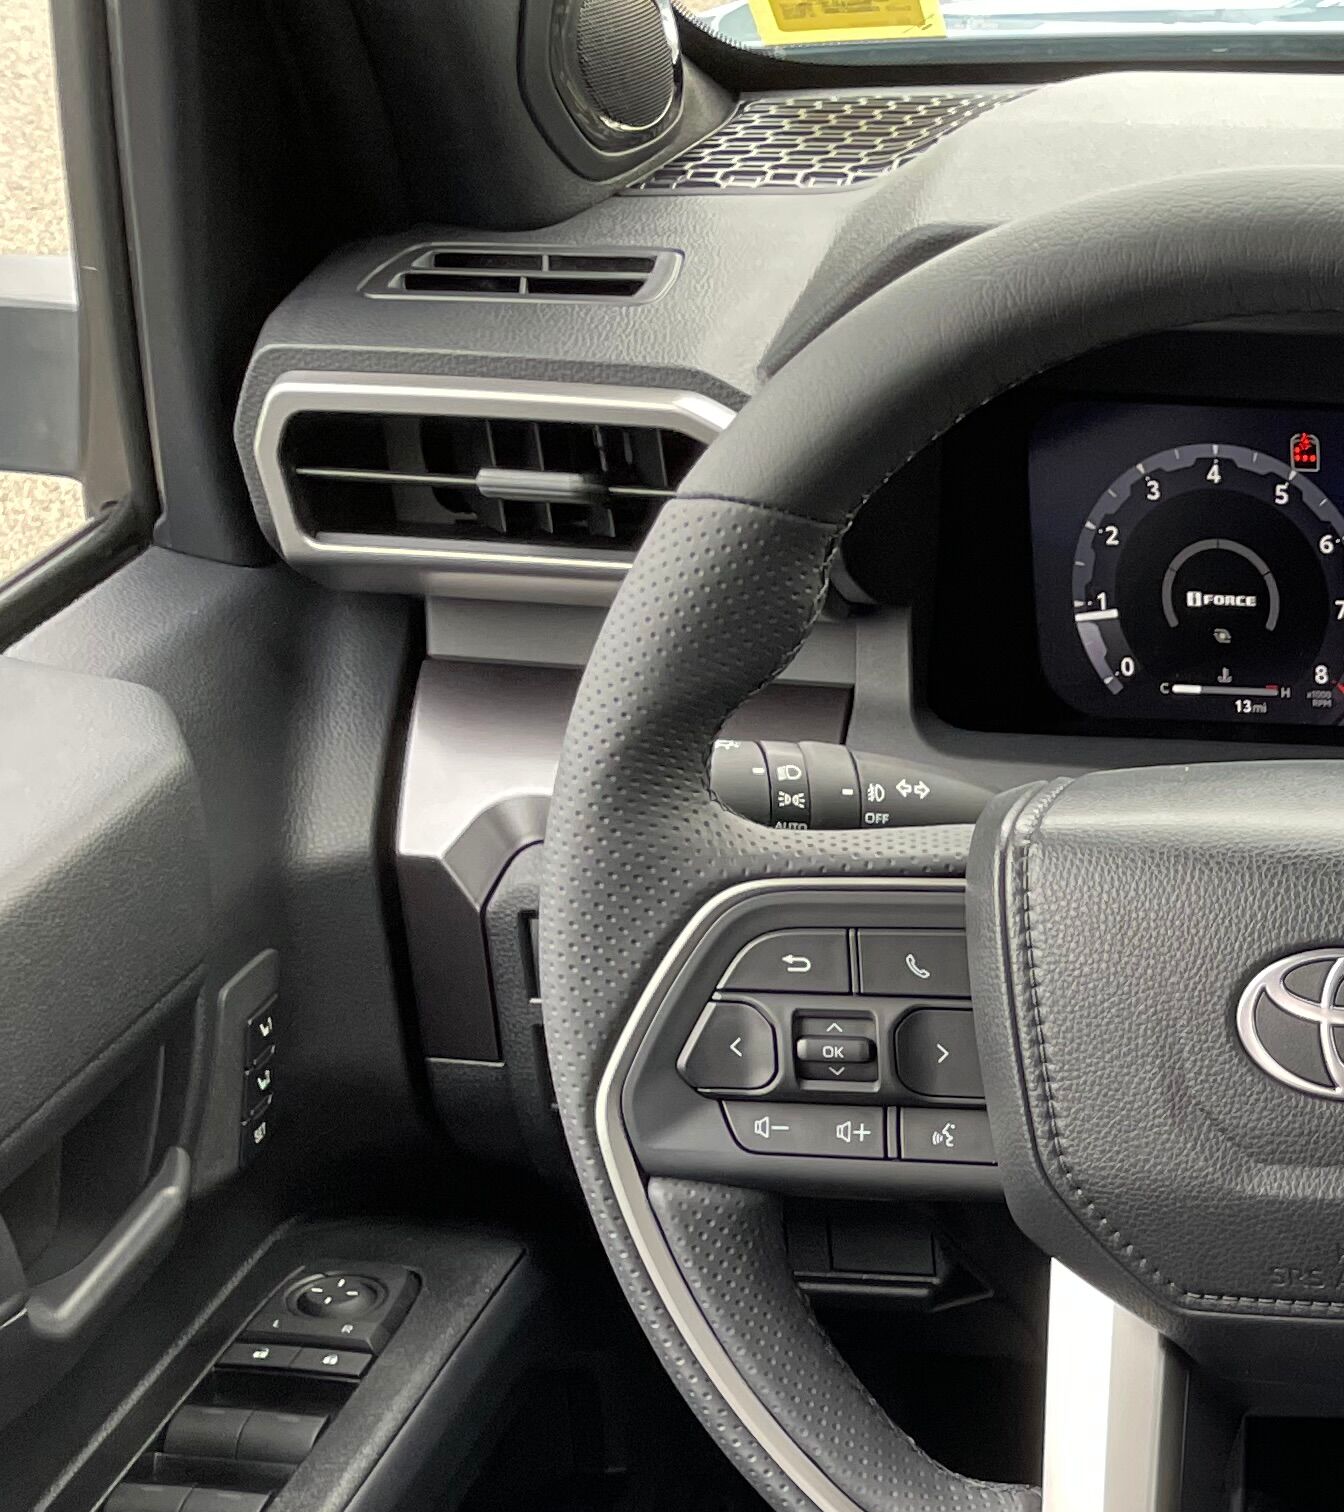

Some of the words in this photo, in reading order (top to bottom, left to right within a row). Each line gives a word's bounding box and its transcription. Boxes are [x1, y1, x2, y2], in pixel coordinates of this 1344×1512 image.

[1207, 463, 1221, 484] 4
[1147, 480, 1161, 500] 3
[1274, 485, 1288, 504] 5
[1105, 525, 1119, 545] 2
[1319, 535, 1333, 554] 6
[1097, 593, 1106, 610] 1
[1120, 658, 1134, 675] 0
[1315, 665, 1328, 684] 8
[1160, 682, 1170, 694] C
[1281, 687, 1291, 699] H
[775, 821, 807, 831] AUTO
[864, 813, 889, 825] OFF
[823, 1045, 844, 1058] OK
